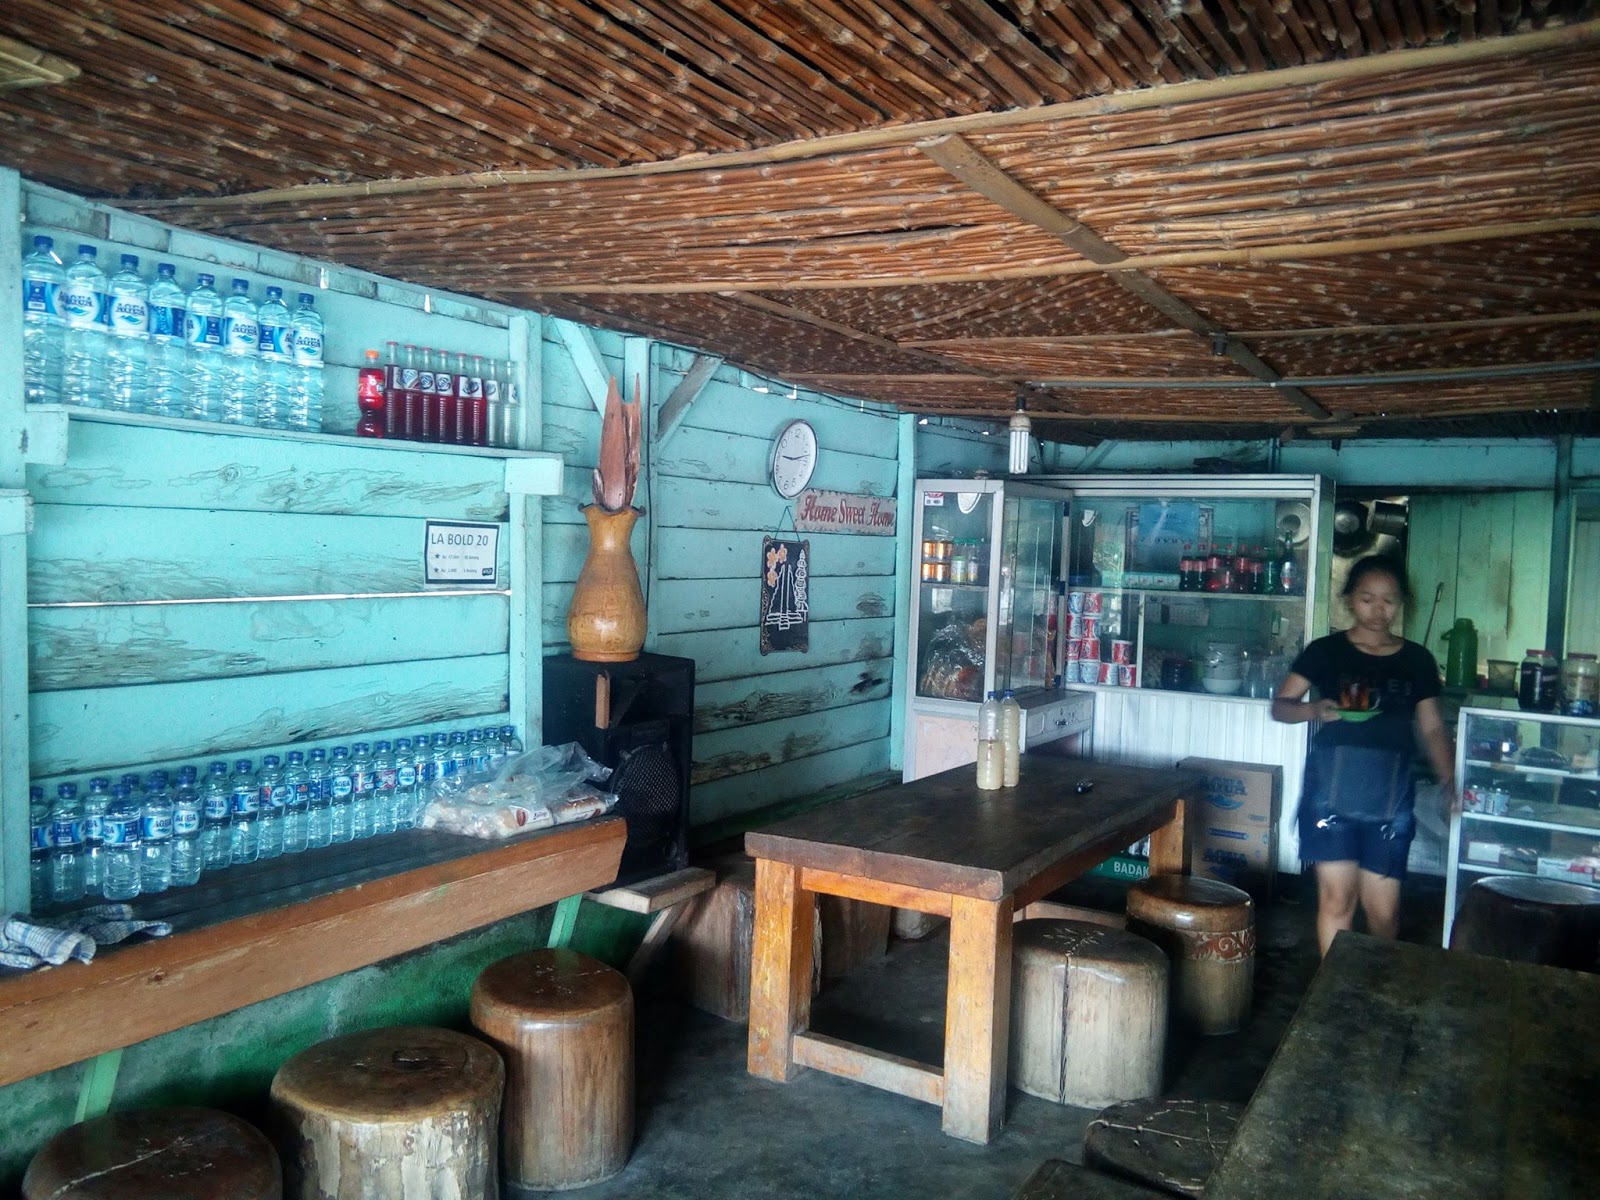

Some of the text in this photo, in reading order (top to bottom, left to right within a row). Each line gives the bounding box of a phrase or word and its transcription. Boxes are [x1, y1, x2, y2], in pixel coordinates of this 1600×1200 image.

[801, 494, 837, 522] Home
[838, 498, 866, 524] Sweet
[431, 533, 489, 546] LA BOLD 20
